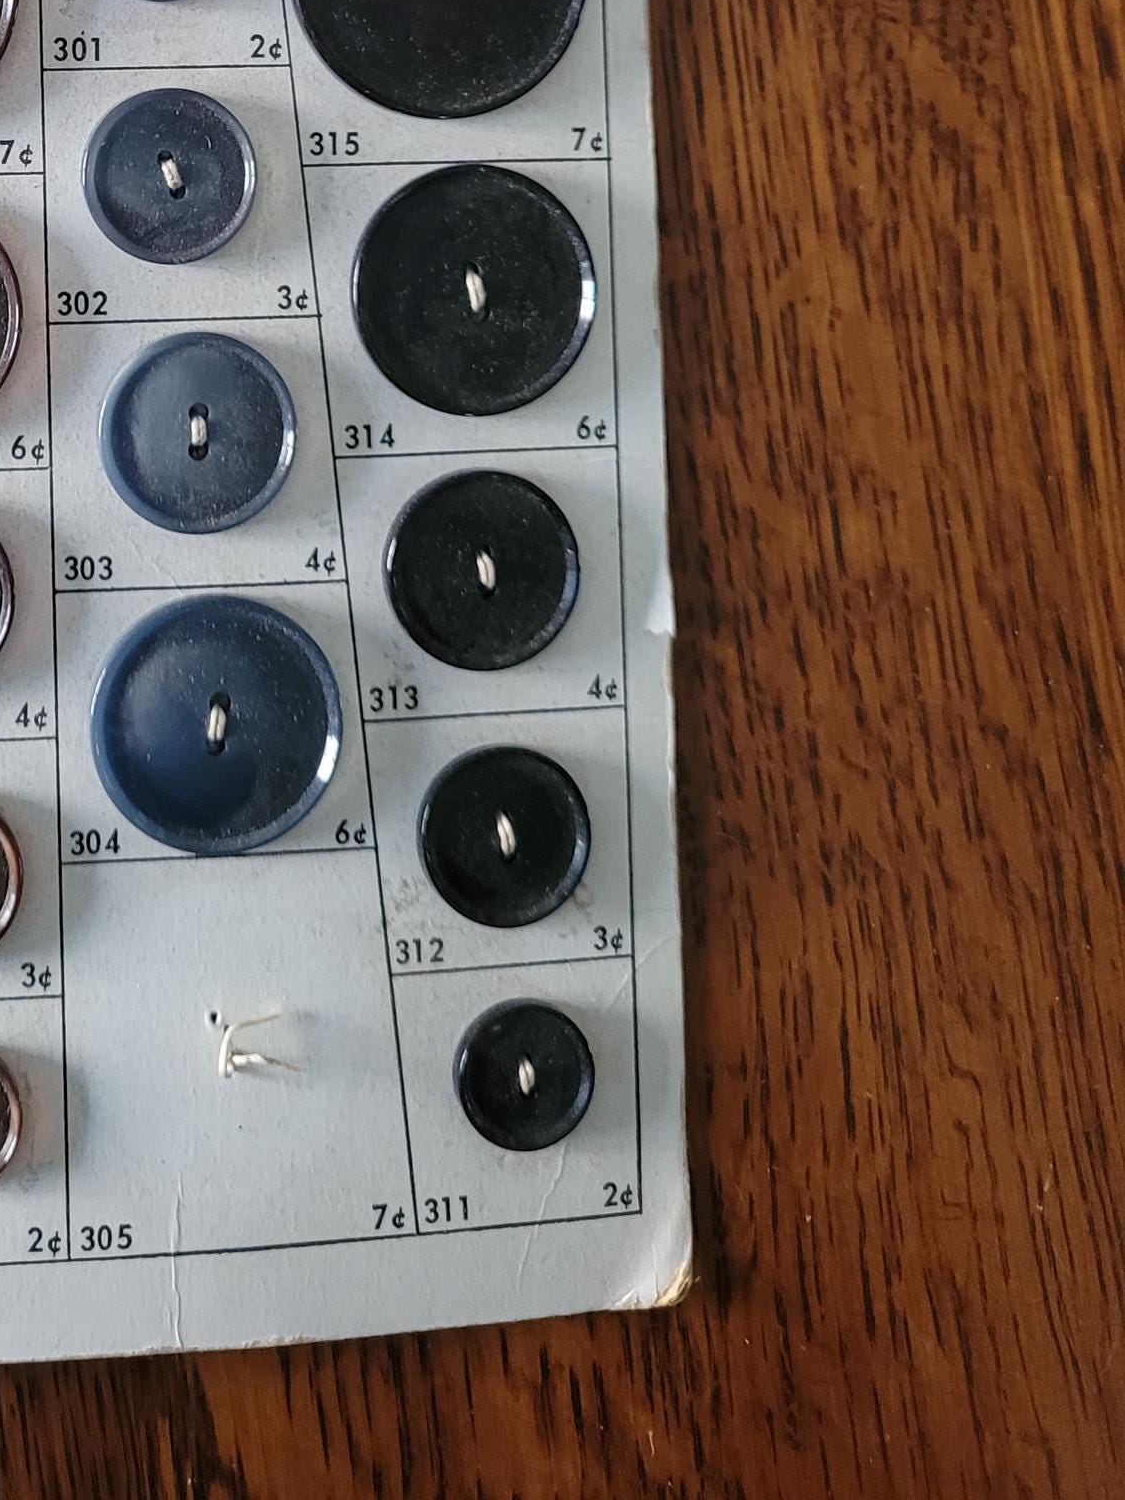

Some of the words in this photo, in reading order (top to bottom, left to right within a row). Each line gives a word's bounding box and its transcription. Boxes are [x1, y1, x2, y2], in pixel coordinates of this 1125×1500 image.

[53, 37, 102, 61] 301
[250, 35, 282, 59] 2¢
[309, 132, 359, 156] 315
[571, 128, 603, 153] 7¢
[57, 291, 107, 316] 302
[277, 286, 309, 311] 3¢
[345, 425, 395, 449] 314
[576, 416, 607, 440] 6¢
[11, 436, 44, 462] 6¢
[64, 556, 113, 580] 303
[305, 550, 336, 575] 4¢
[369, 686, 419, 711] 313
[587, 675, 617, 700] 4¢
[15, 704, 47, 730] 4¢
[70, 830, 120, 854] 304
[335, 821, 366, 846] 6¢
[395, 938, 445, 963] 312
[594, 927, 624, 952] 3¢
[21, 963, 52, 989] 3¢
[603, 1183, 632, 1208] 2¢
[372, 1205, 405, 1230] 7¢
[424, 1196, 470, 1222] 311
[28, 1229, 61, 1255] 2¢
[80, 1225, 132, 1251] 305
